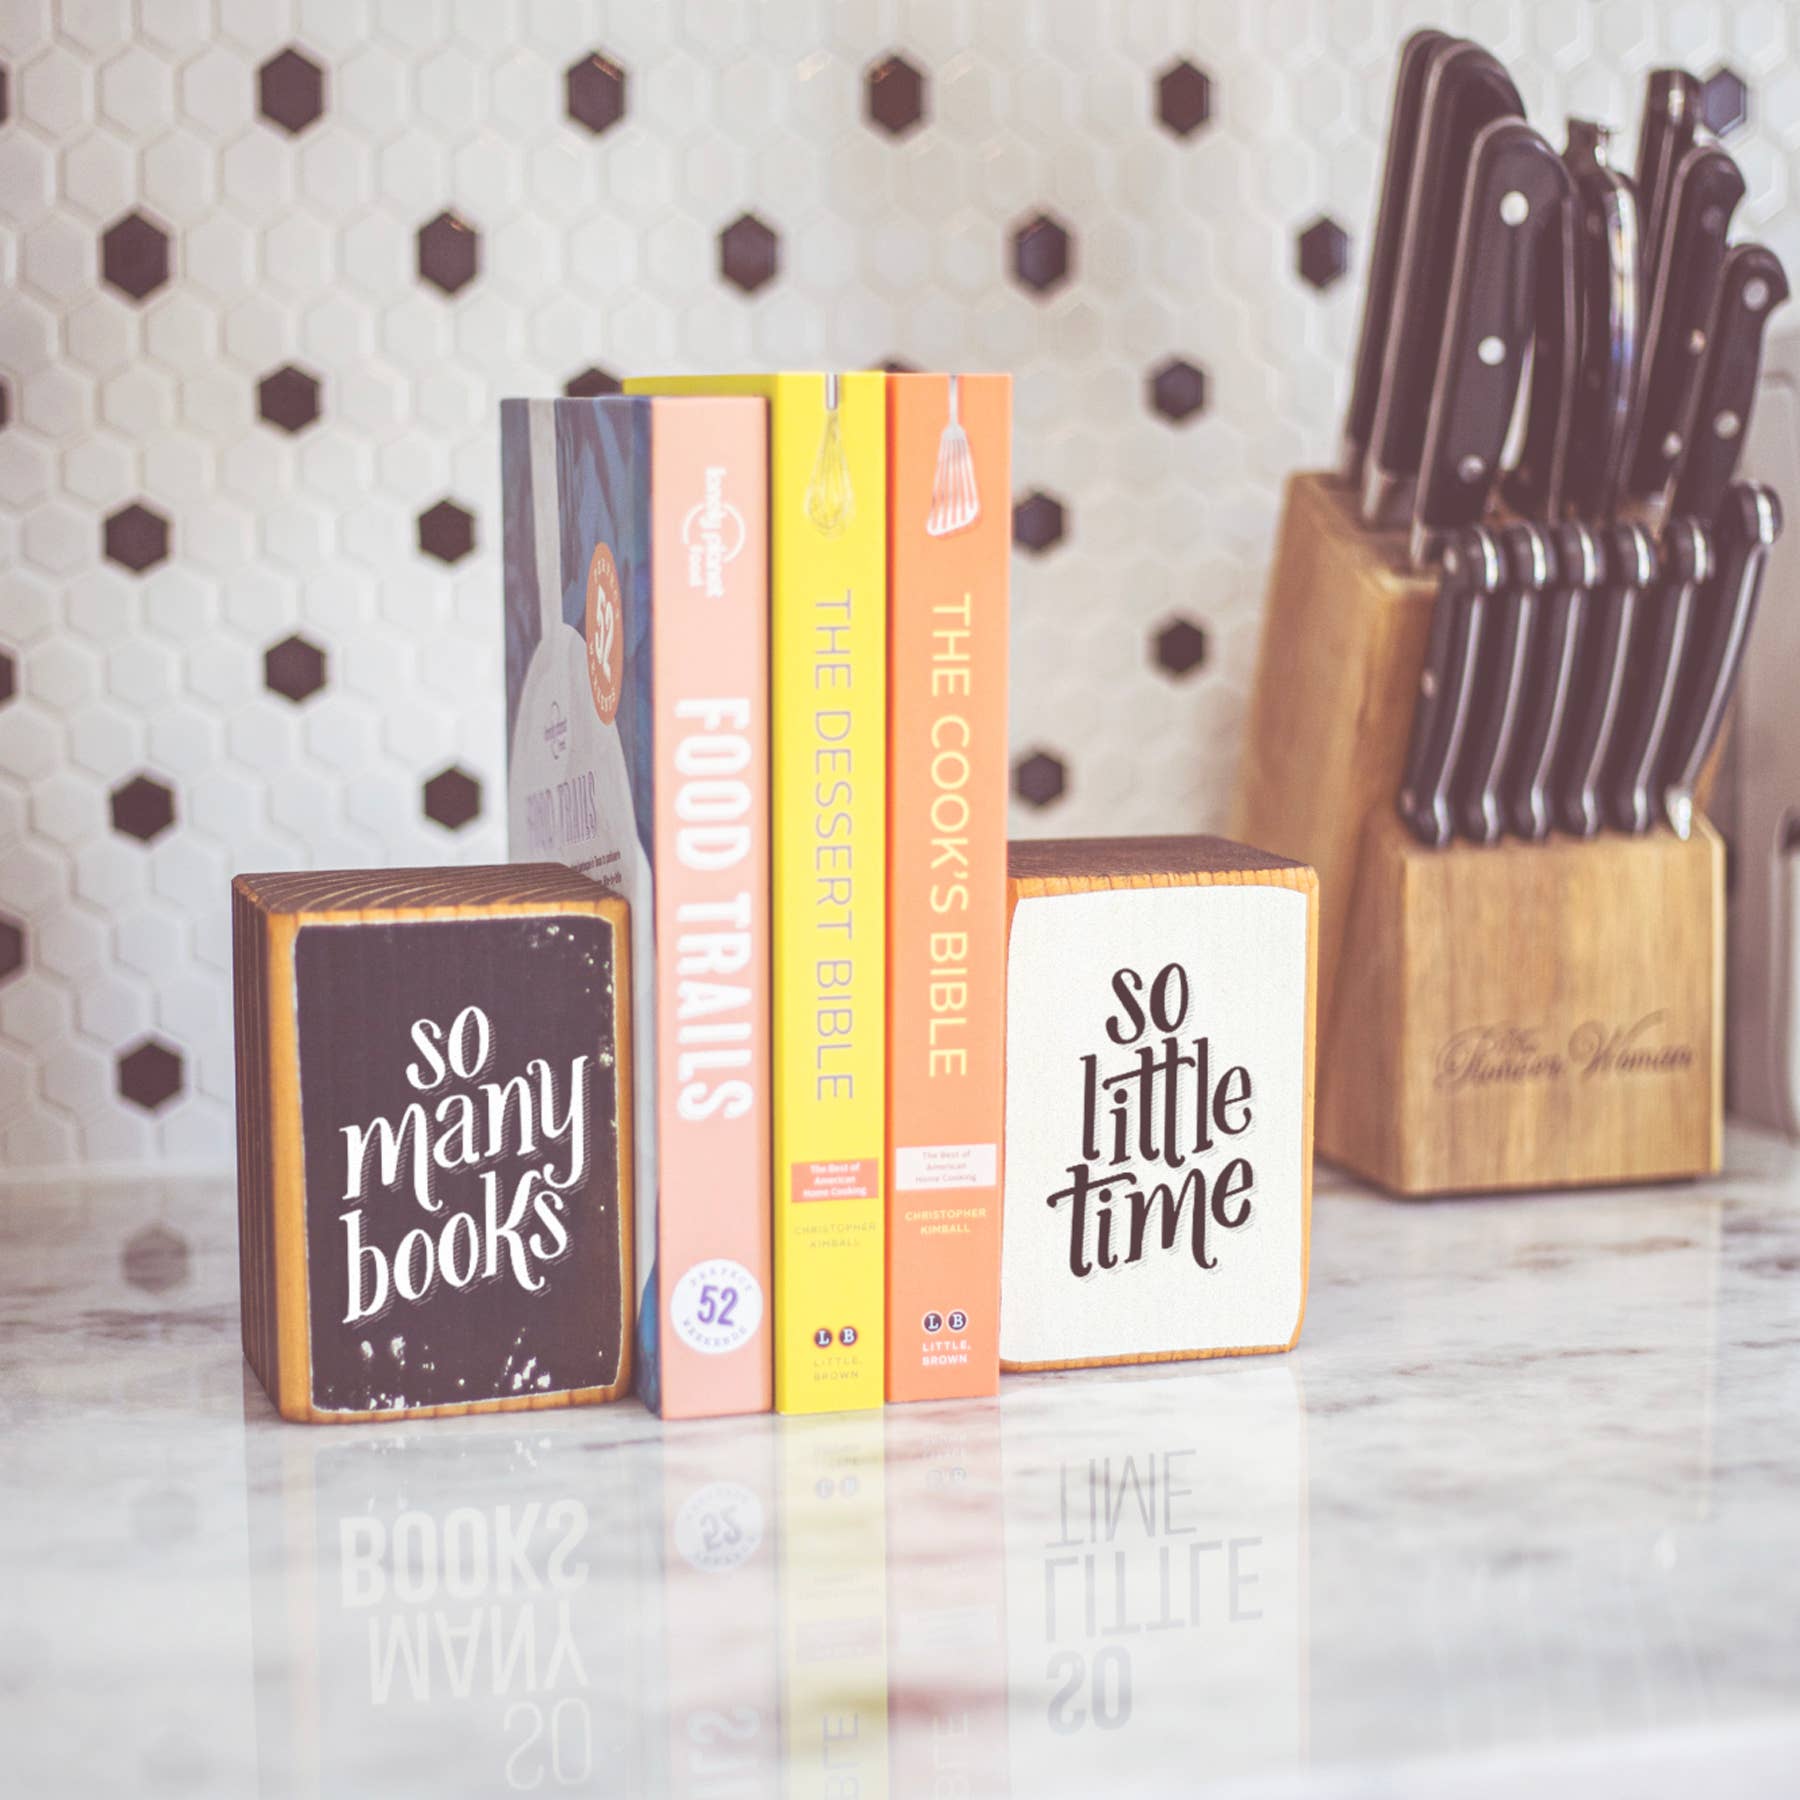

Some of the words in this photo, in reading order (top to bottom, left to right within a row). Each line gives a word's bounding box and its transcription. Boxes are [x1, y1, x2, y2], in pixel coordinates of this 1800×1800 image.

[594, 584, 615, 684] 52
[814, 589, 852, 690] THE
[929, 593, 971, 697] THE
[674, 697, 752, 871] FOOD
[815, 711, 853, 940] DESSERT
[929, 714, 971, 914] COOK'S
[406, 1004, 492, 1090] so
[676, 891, 754, 1121] TRAILS
[816, 959, 853, 1101] BIBLE
[929, 932, 968, 1078] BIBLE
[1106, 962, 1190, 1045] so
[340, 1055, 589, 1212] many
[1079, 1037, 1253, 1169] little
[803, 1189, 829, 1198] Home
[831, 1186, 867, 1197] Cooking
[810, 1164, 827, 1174] The
[828, 1163, 849, 1173] Best
[850, 1161, 861, 1172] of
[814, 1176, 856, 1186] American
[915, 1175, 940, 1184] Home
[942, 1173, 977, 1184] Cooking
[922, 1151, 938, 1161] The
[940, 1150, 961, 1160] Best
[962, 1150, 971, 1159] of
[926, 1162, 968, 1171] American
[340, 1169, 570, 1324] books
[904, 1207, 987, 1221] CHRISTOPHER
[920, 1225, 972, 1236] KIMBALL
[1046, 1158, 1254, 1278] time
[697, 1284, 740, 1327] 52
[921, 1354, 968, 1366] BROWN
